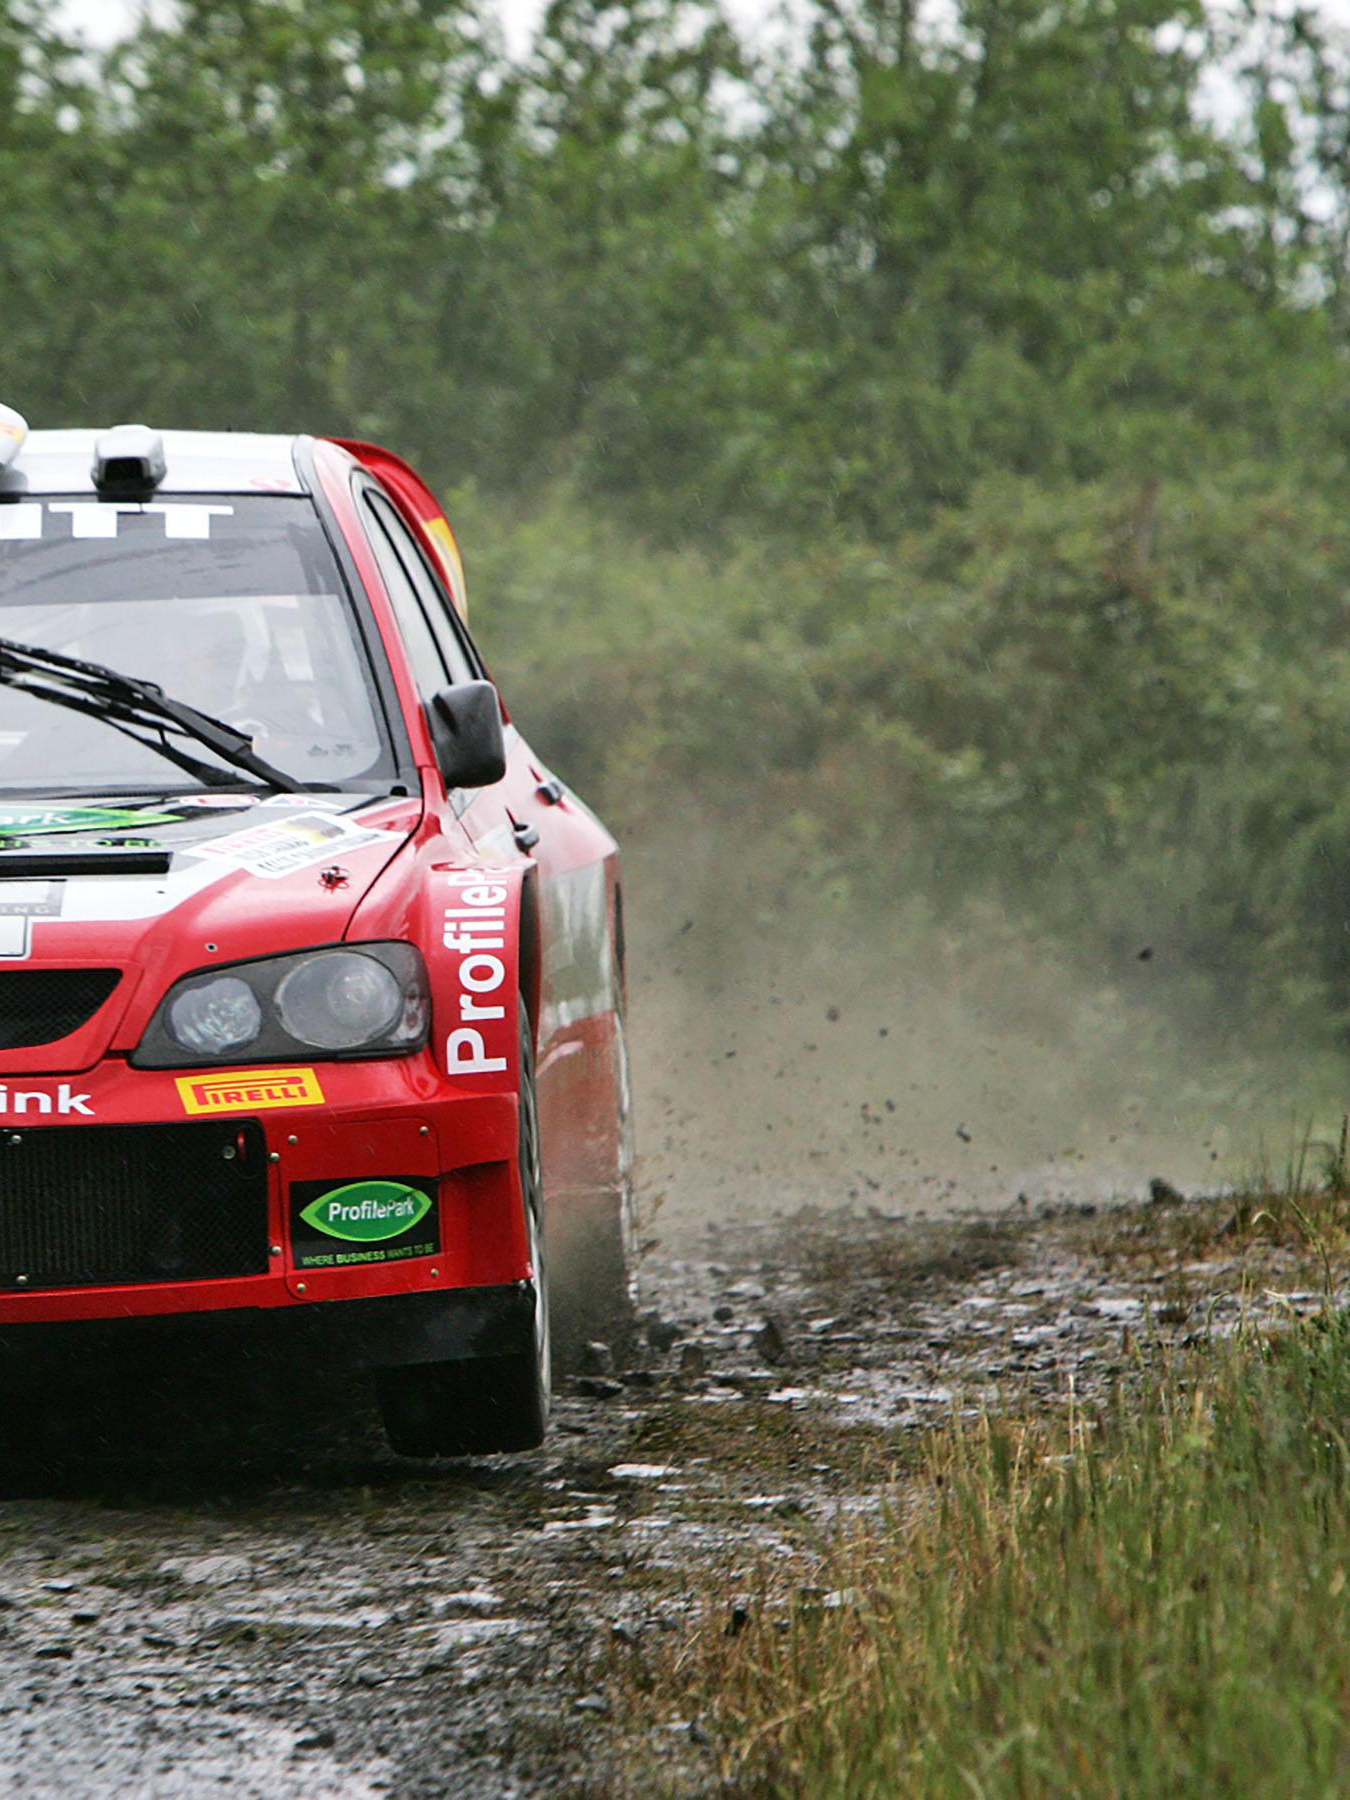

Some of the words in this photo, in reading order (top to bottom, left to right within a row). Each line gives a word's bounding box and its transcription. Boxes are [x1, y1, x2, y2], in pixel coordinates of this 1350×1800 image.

[443, 868, 507, 1075] ProfileP
[191, 1076, 308, 1106] PIRELLI
[328, 1197, 414, 1222] ProfilePark
[302, 1254, 335, 1266] WHERE
[336, 1250, 386, 1264] BUSINESS
